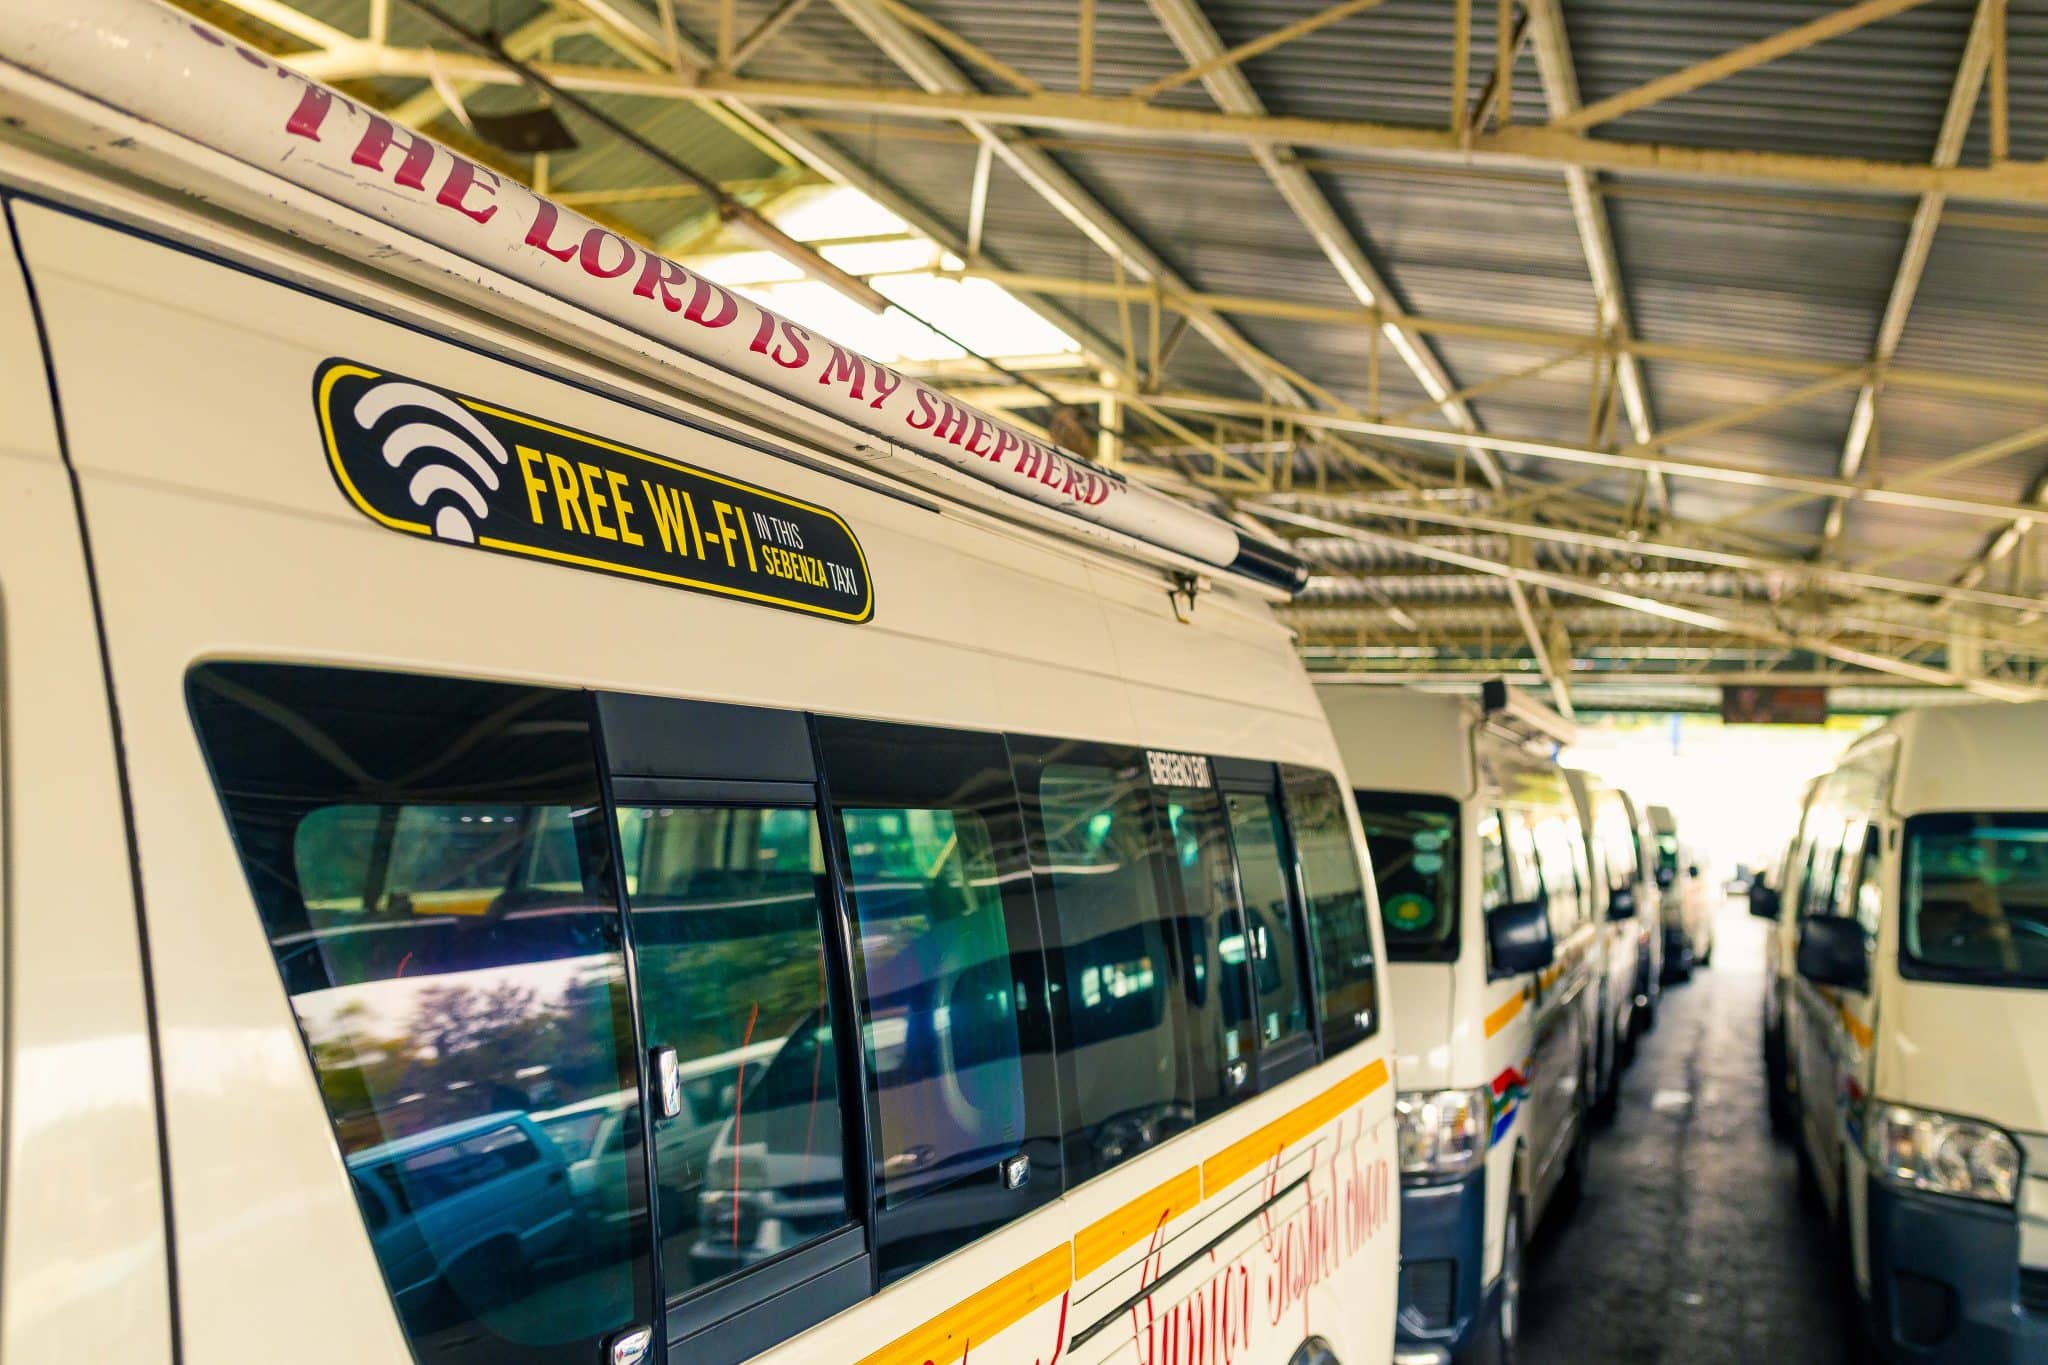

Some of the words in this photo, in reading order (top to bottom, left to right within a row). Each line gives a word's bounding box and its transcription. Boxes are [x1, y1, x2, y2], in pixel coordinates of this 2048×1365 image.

[524, 197, 739, 328] LORD
[748, 316, 811, 369] IS
[818, 344, 902, 410] MY
[515, 444, 644, 547] FREE
[641, 479, 758, 573] WI-FI
[752, 511, 773, 542] IN
[769, 516, 804, 550] THIS
[761, 544, 829, 589] SEBENZA
[826, 561, 858, 596] TAXI
